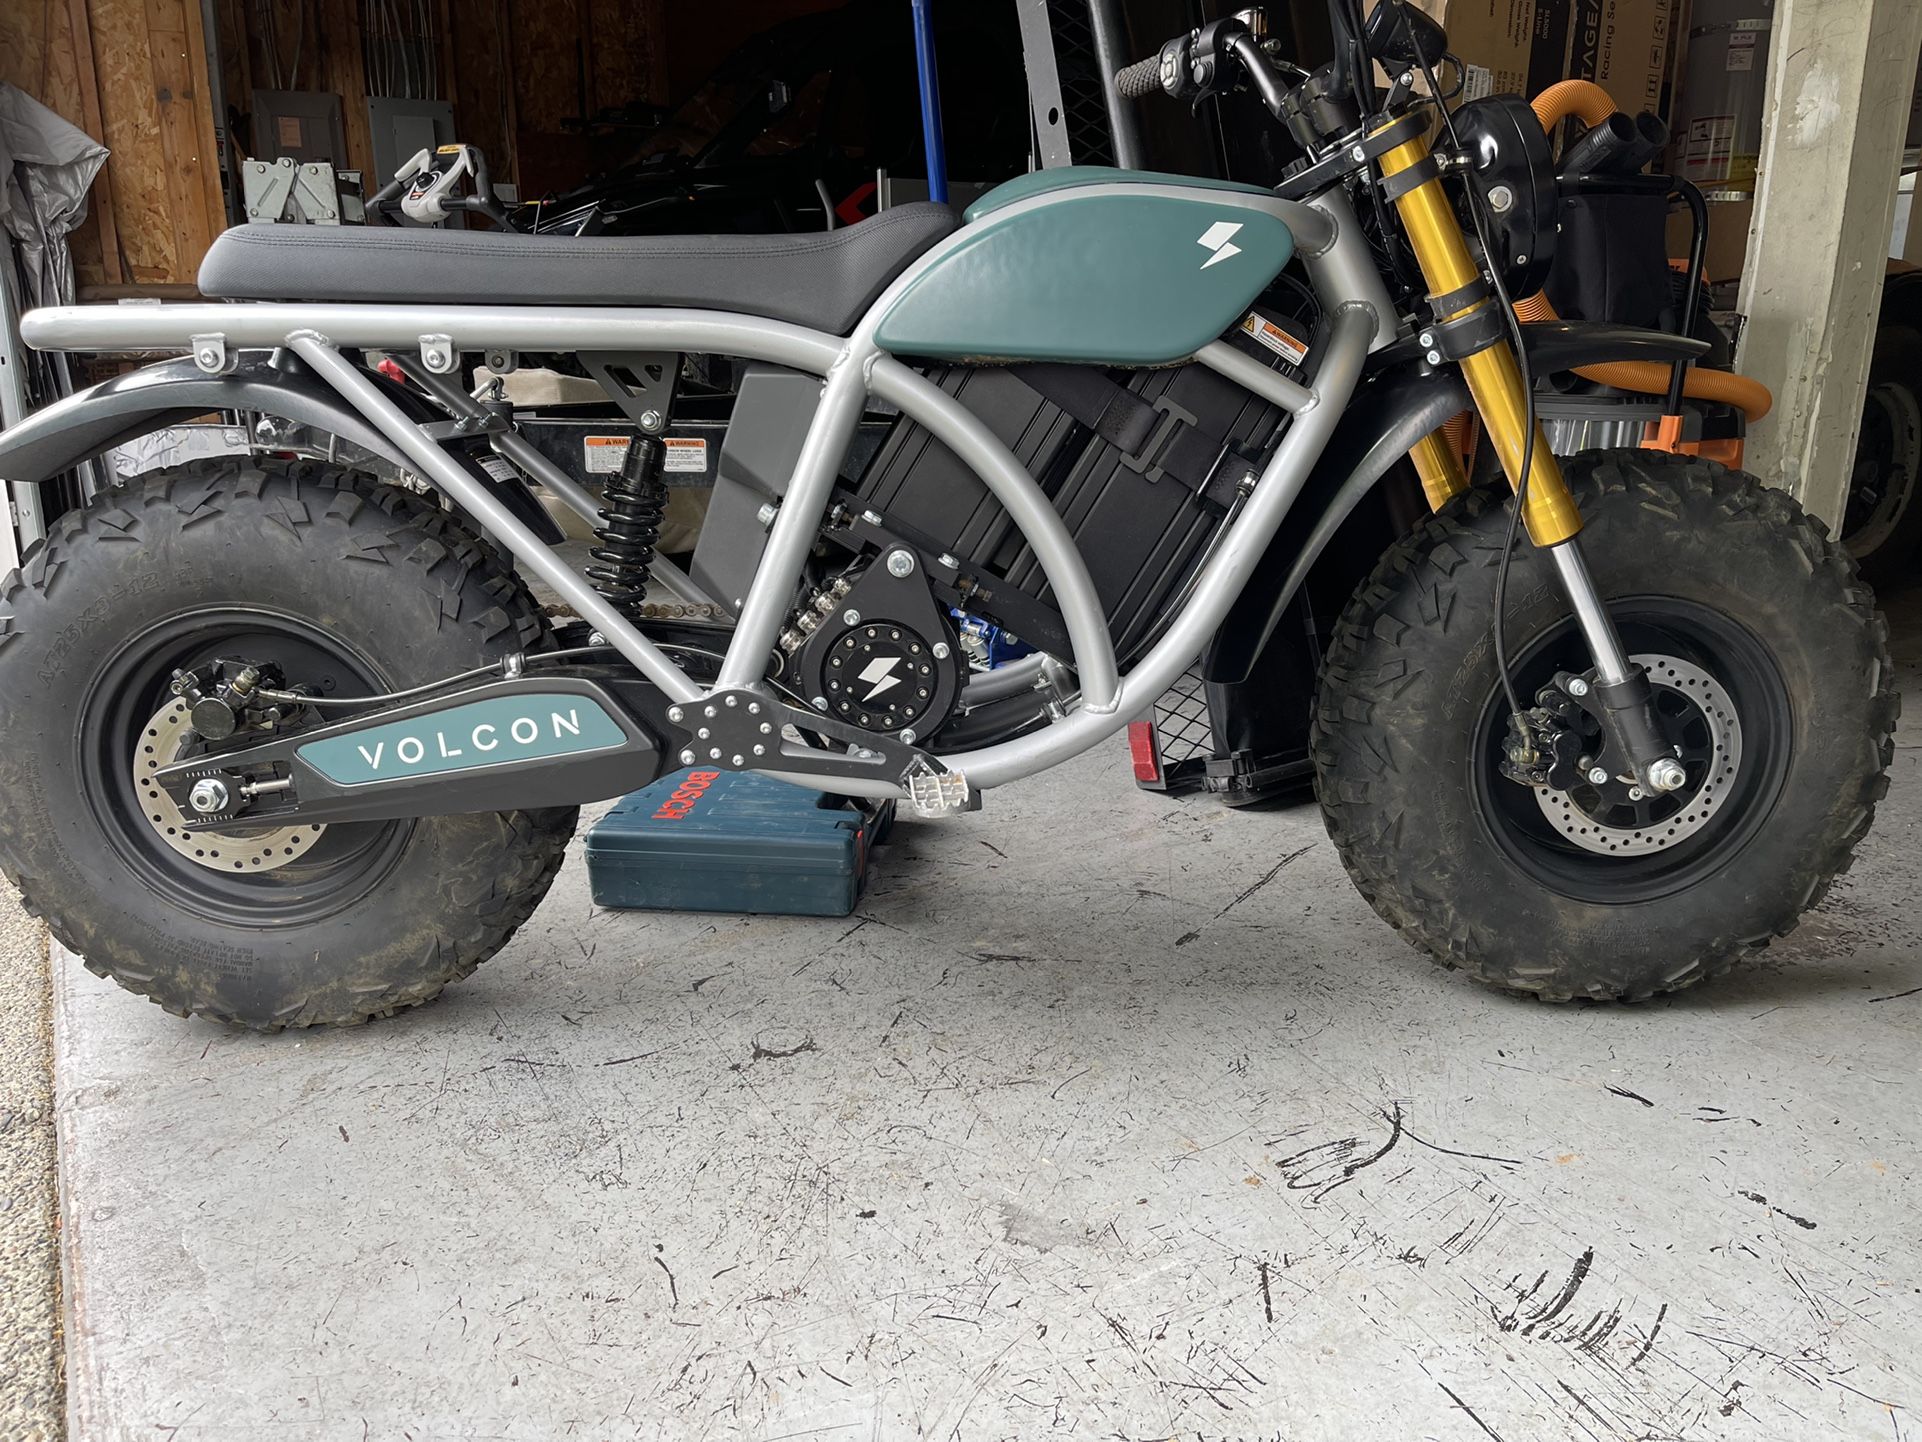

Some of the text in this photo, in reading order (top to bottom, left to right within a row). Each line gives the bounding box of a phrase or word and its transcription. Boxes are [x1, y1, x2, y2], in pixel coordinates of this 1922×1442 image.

[1600, 25, 1614, 81] Racing
[357, 708, 581, 769] VOLCON
[651, 770, 721, 820] BOSCH
